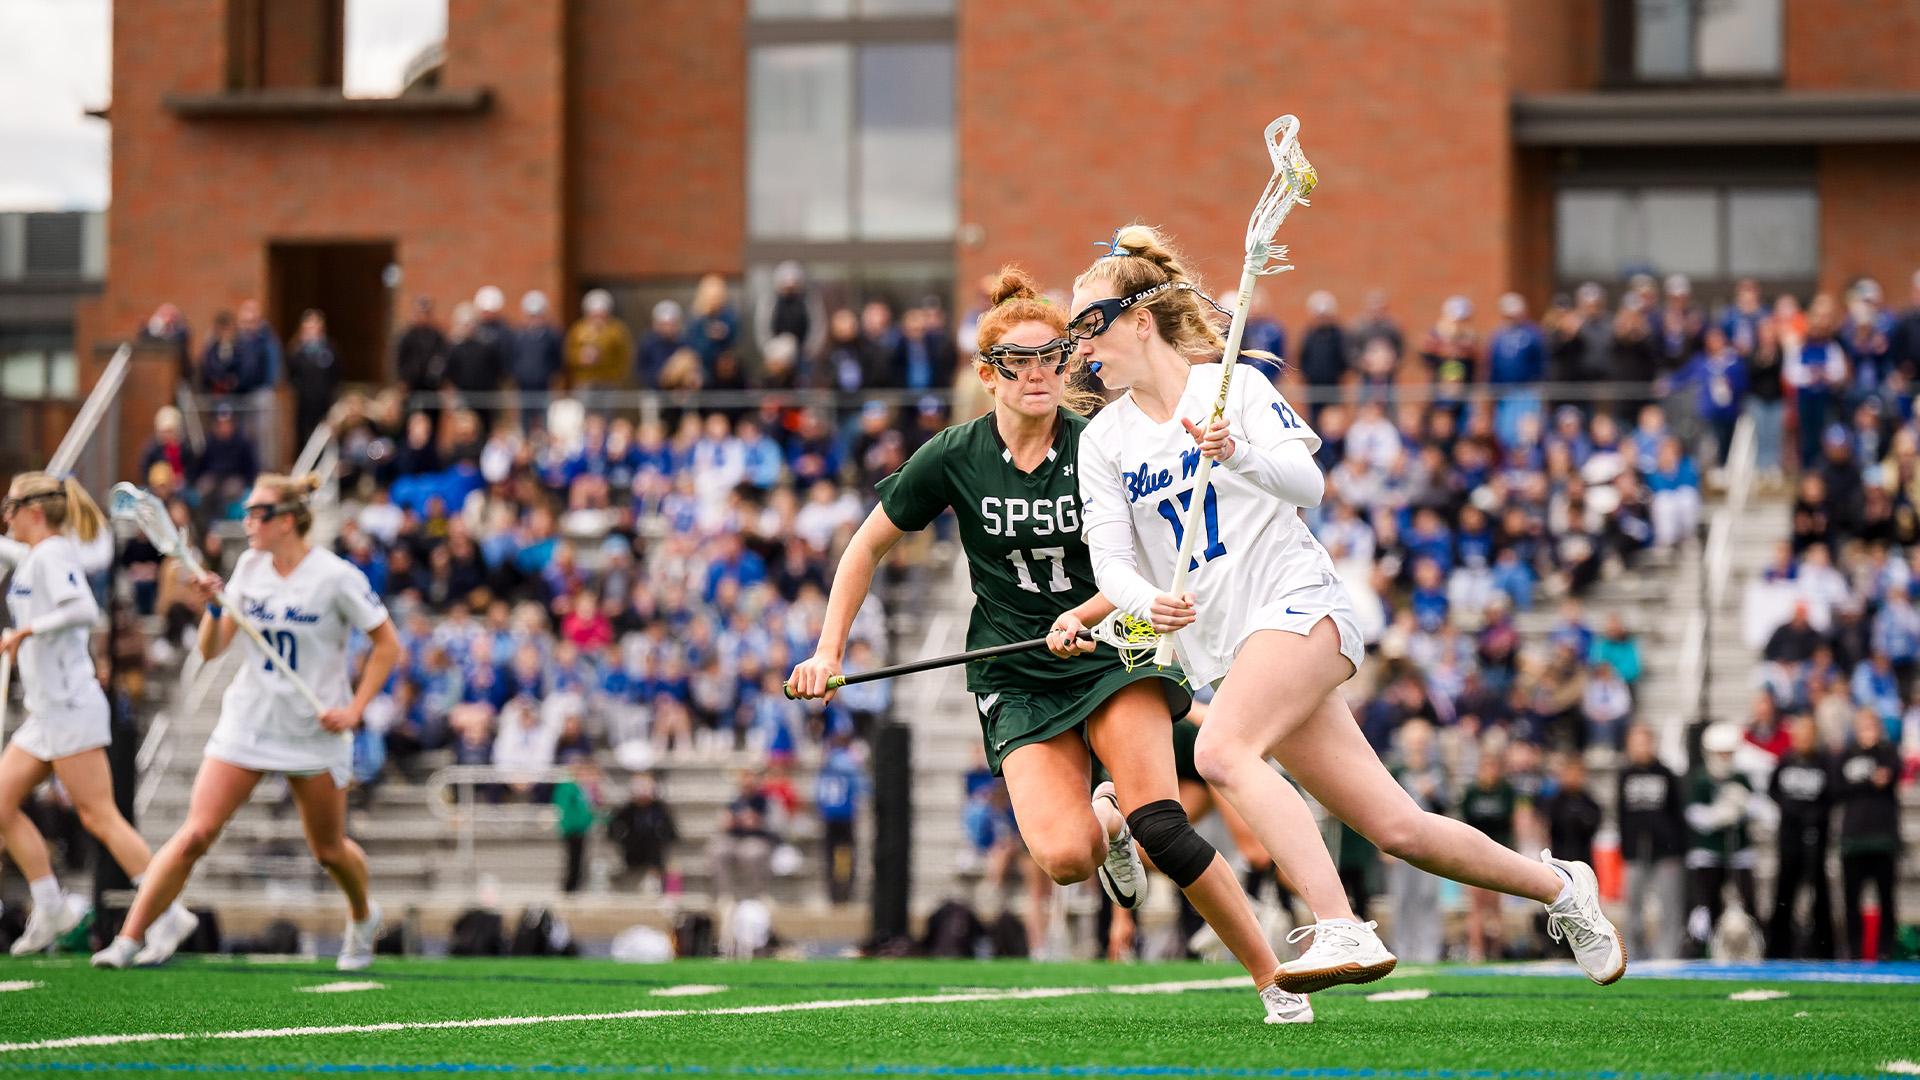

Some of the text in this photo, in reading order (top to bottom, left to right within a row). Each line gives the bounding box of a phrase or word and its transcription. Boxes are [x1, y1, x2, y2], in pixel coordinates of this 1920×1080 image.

[1135, 287, 1157, 300] GAIT
[1121, 461, 1174, 504] Blue
[981, 494, 1080, 537] SPSG
[1156, 481, 1228, 573] 17
[1005, 546, 1073, 593] 17
